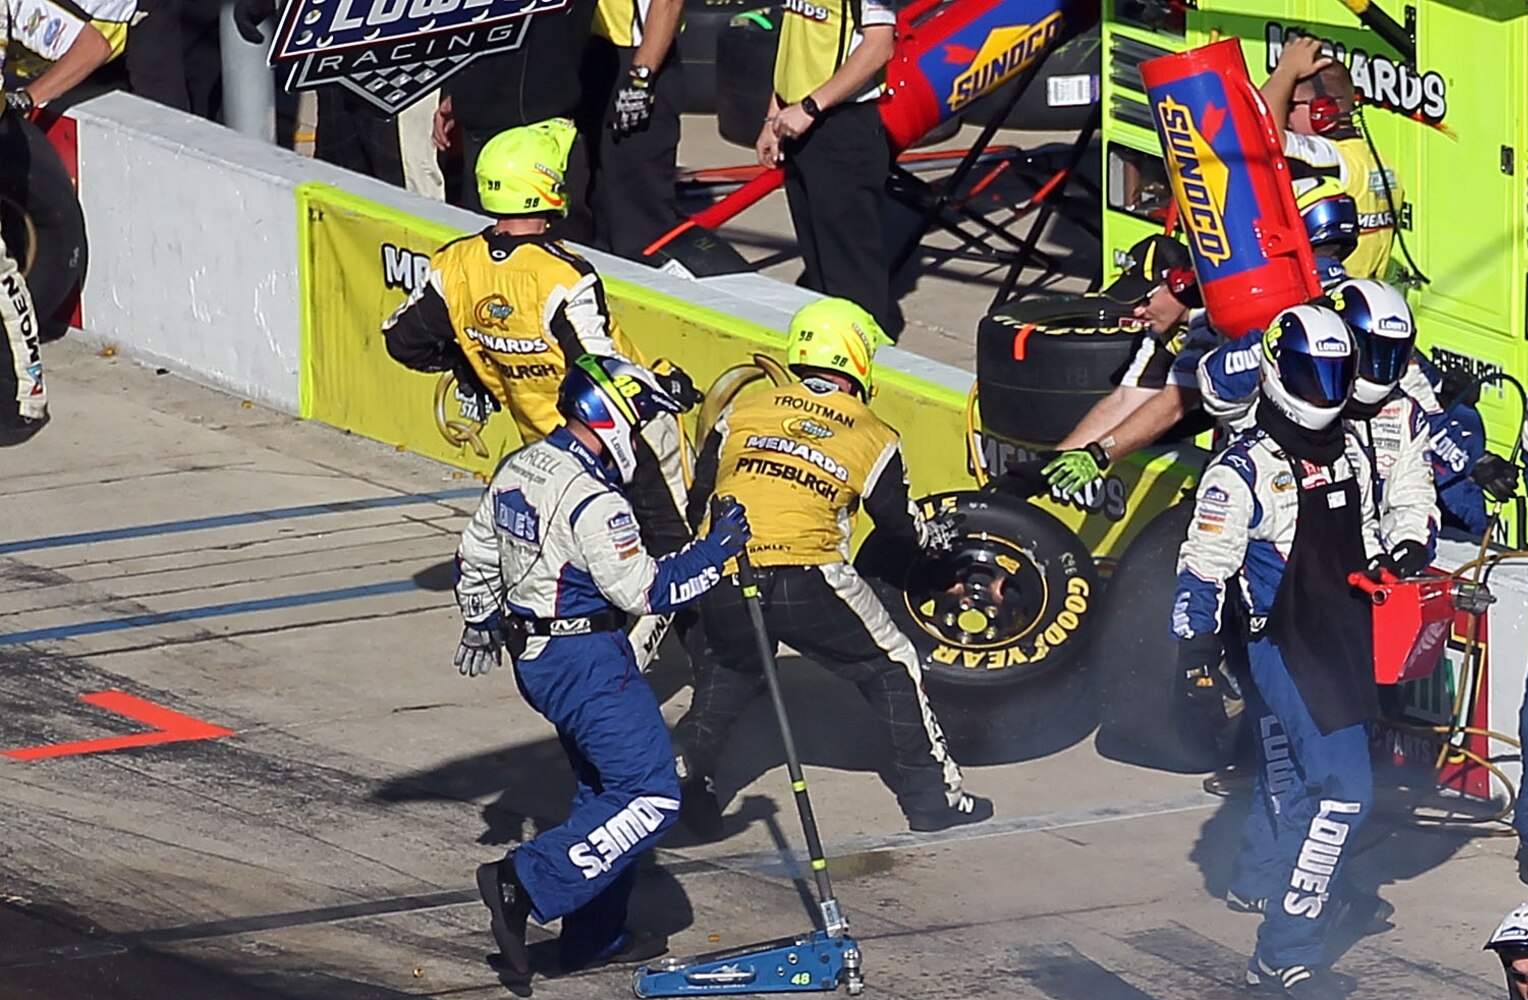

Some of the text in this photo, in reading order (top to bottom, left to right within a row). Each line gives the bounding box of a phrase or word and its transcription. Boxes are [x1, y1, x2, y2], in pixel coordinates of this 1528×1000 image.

[316, 23, 514, 73] RACING
[950, 18, 1062, 105] SUNOCO
[523, 197, 540, 209] 98
[1162, 104, 1226, 256] SUNOCO
[2, 275, 41, 364] MOEN
[831, 354, 849, 368] 98
[614, 374, 642, 398] 48
[774, 396, 855, 428] TROUTMAN
[745, 435, 849, 482] MENARDS
[1429, 427, 1470, 473] LOWE'S
[748, 544, 793, 554] OAKLEY
[670, 564, 722, 606] LOWE'S
[932, 576, 1090, 669] GOODYEAR
[569, 794, 682, 882] LOWE'S
[1283, 800, 1362, 919] LOWE'S
[791, 973, 811, 986] 48
